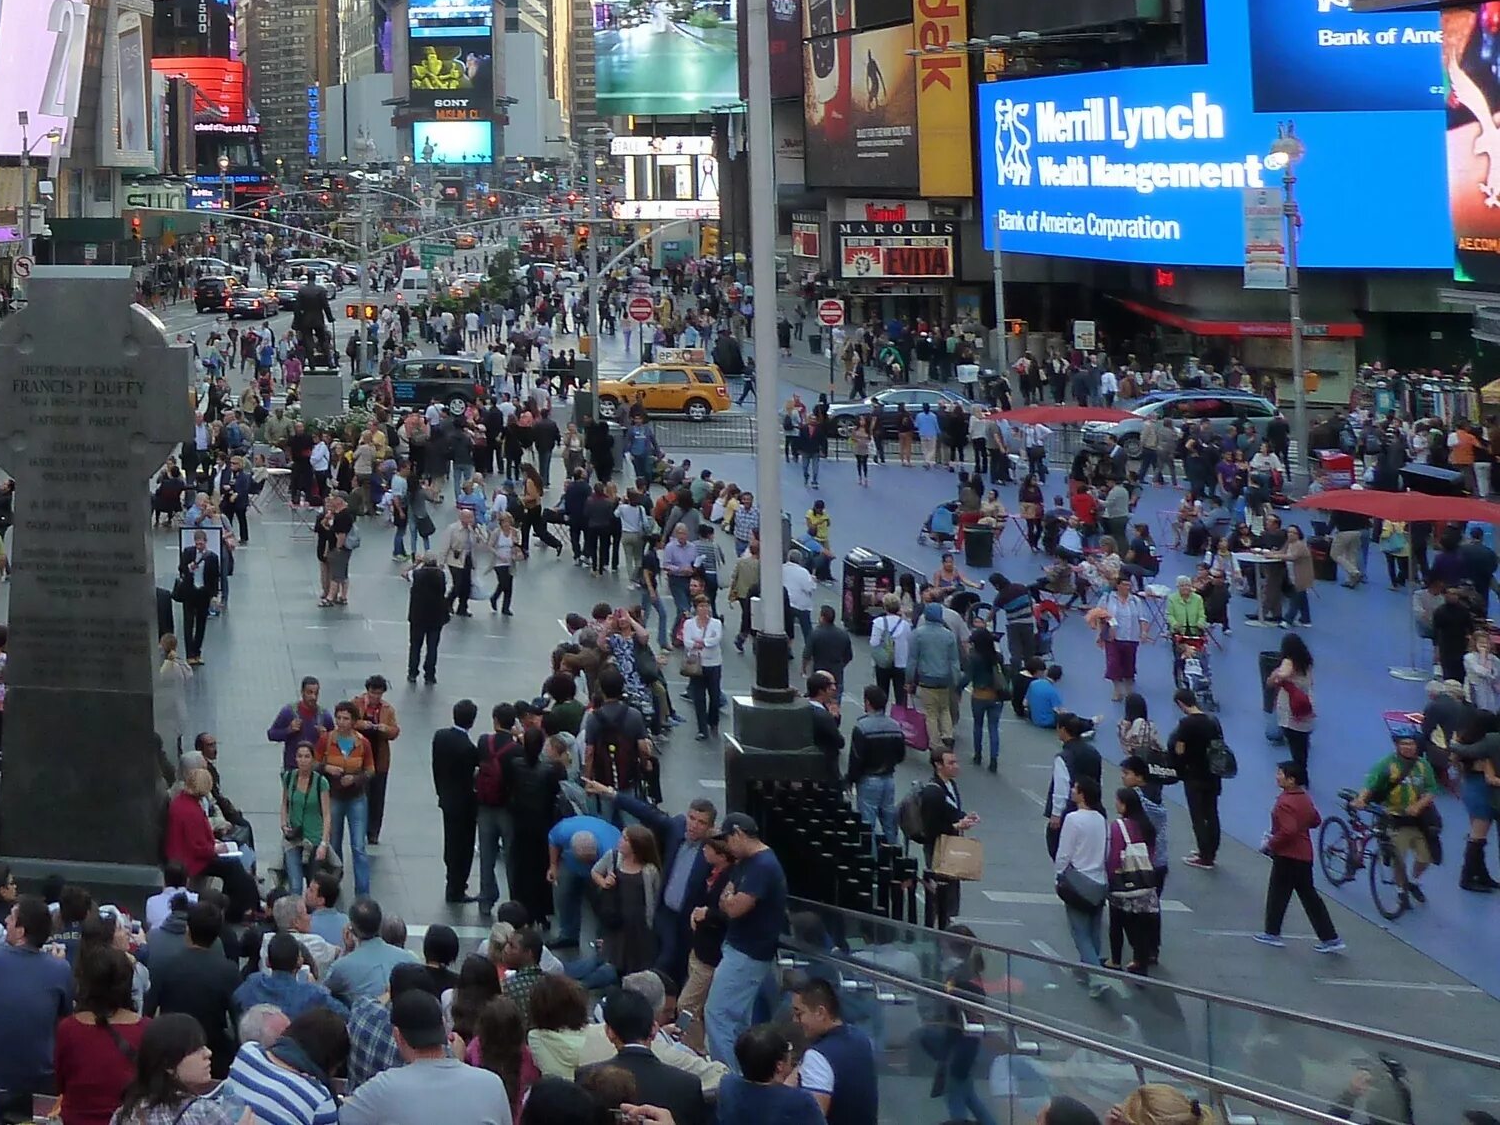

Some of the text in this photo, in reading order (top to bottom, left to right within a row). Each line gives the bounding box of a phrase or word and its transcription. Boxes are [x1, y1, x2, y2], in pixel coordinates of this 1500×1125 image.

[1318, 29, 1370, 46] Bank
[1376, 29, 1396, 44] of
[434, 99, 469, 107] SONY
[1036, 92, 1225, 148] Merrill Lynch
[1037, 155, 1263, 194] Wealth Management
[840, 224, 953, 233] MARQUIS
[999, 210, 1180, 240] Bank of America Corporation
[12, 380, 72, 394] FRANCIS
[93, 380, 146, 395] DUFFY
